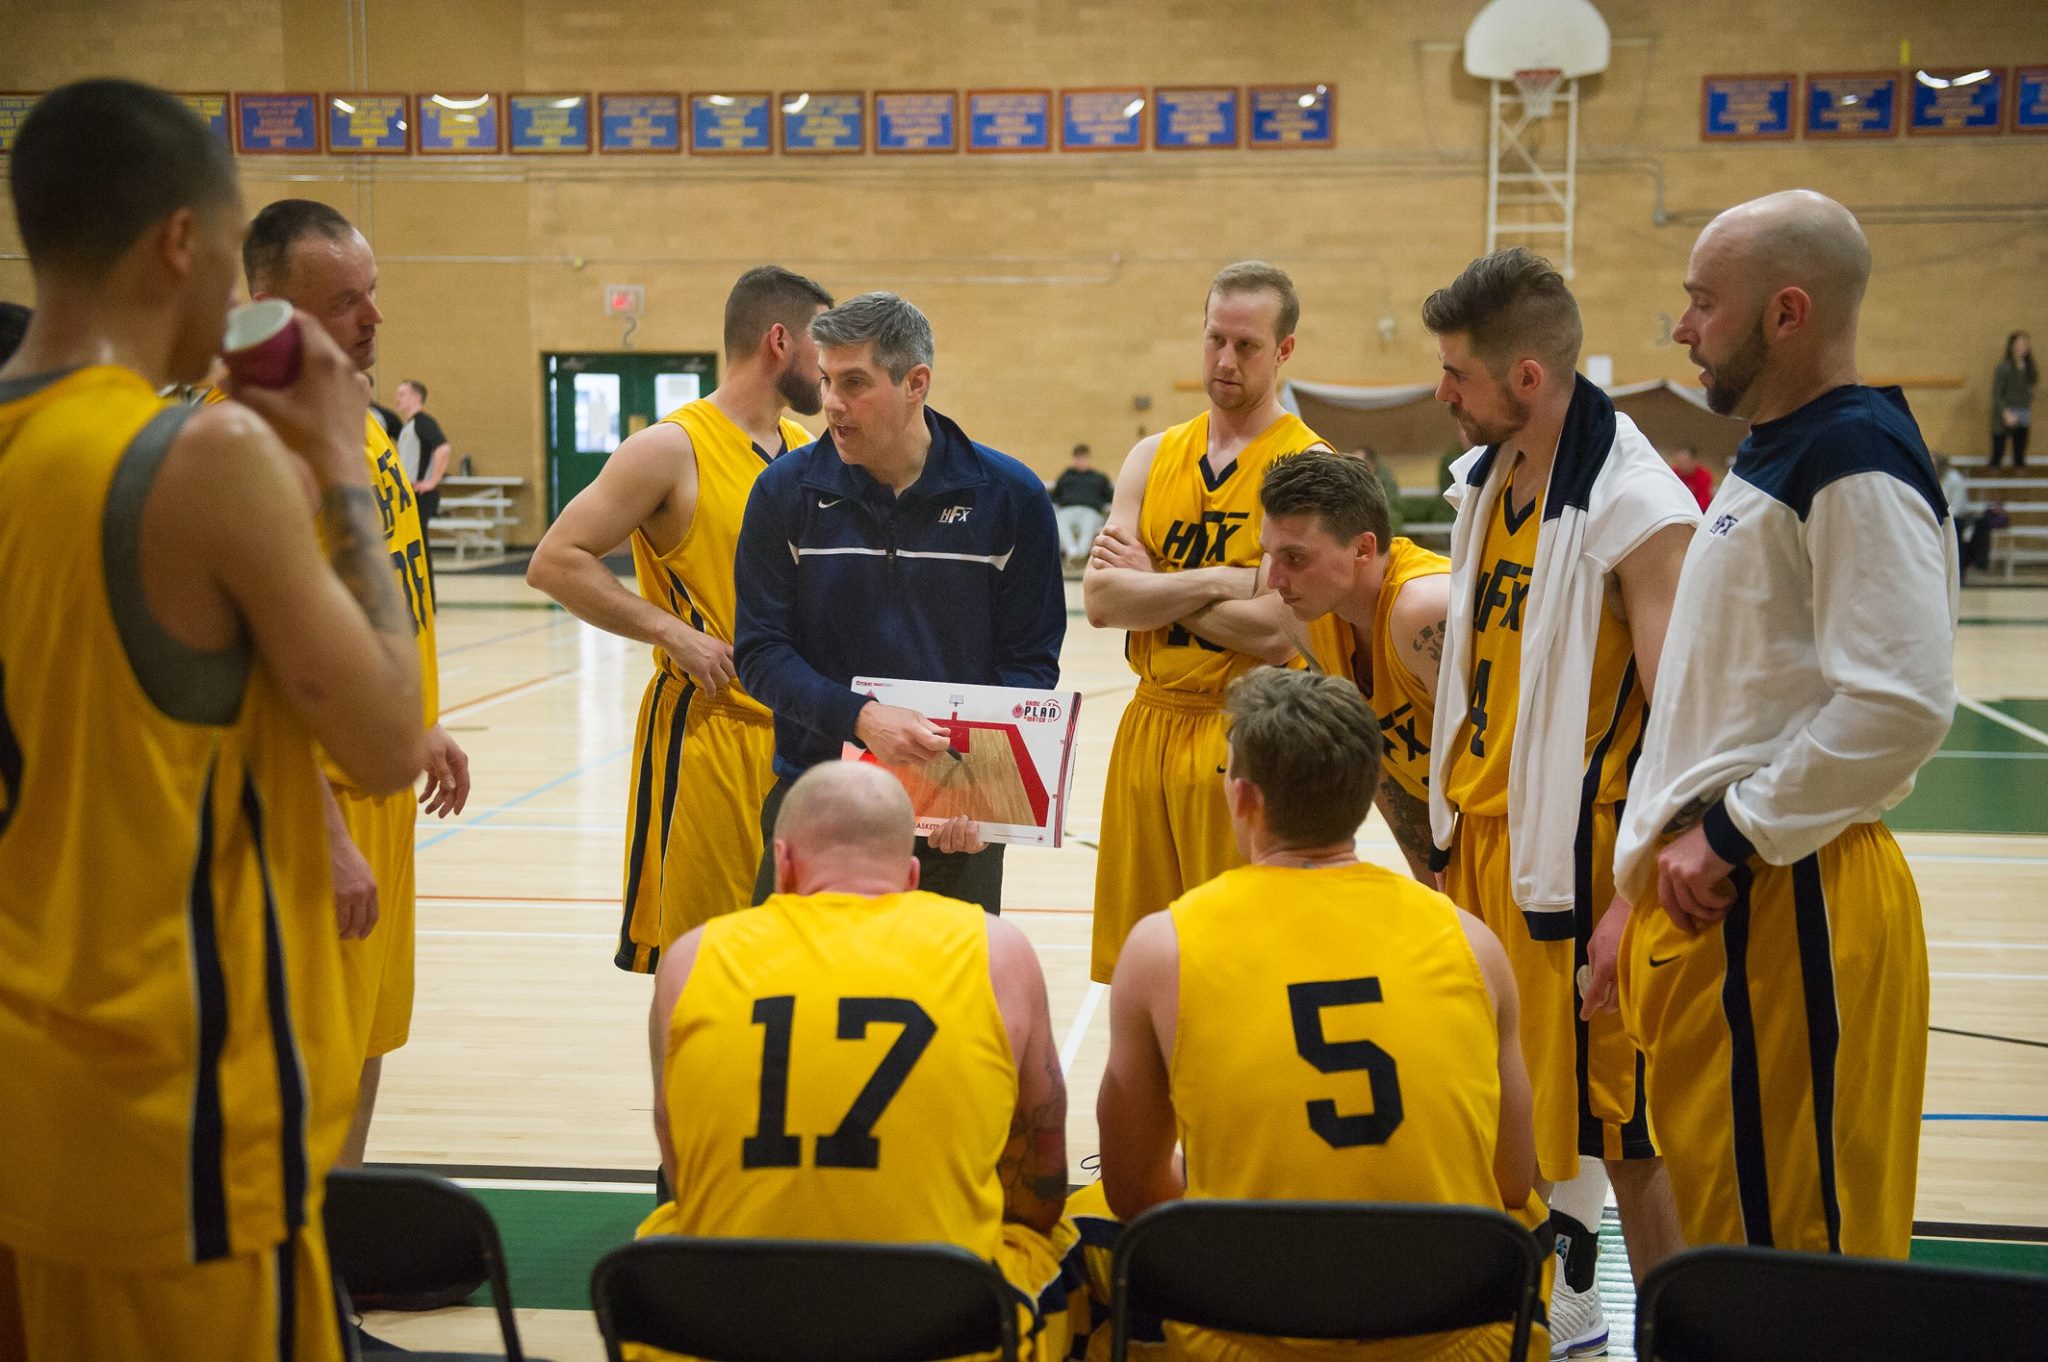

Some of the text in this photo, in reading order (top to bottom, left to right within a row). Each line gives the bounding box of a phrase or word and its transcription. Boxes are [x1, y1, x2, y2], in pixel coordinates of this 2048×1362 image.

[938, 506, 973, 524] HFX
[1162, 511, 1250, 569] HFX
[1024, 706, 1057, 718] PLAN
[1470, 658, 1492, 758] 4
[741, 994, 938, 1170] 17
[1287, 975, 1405, 1150] 5
